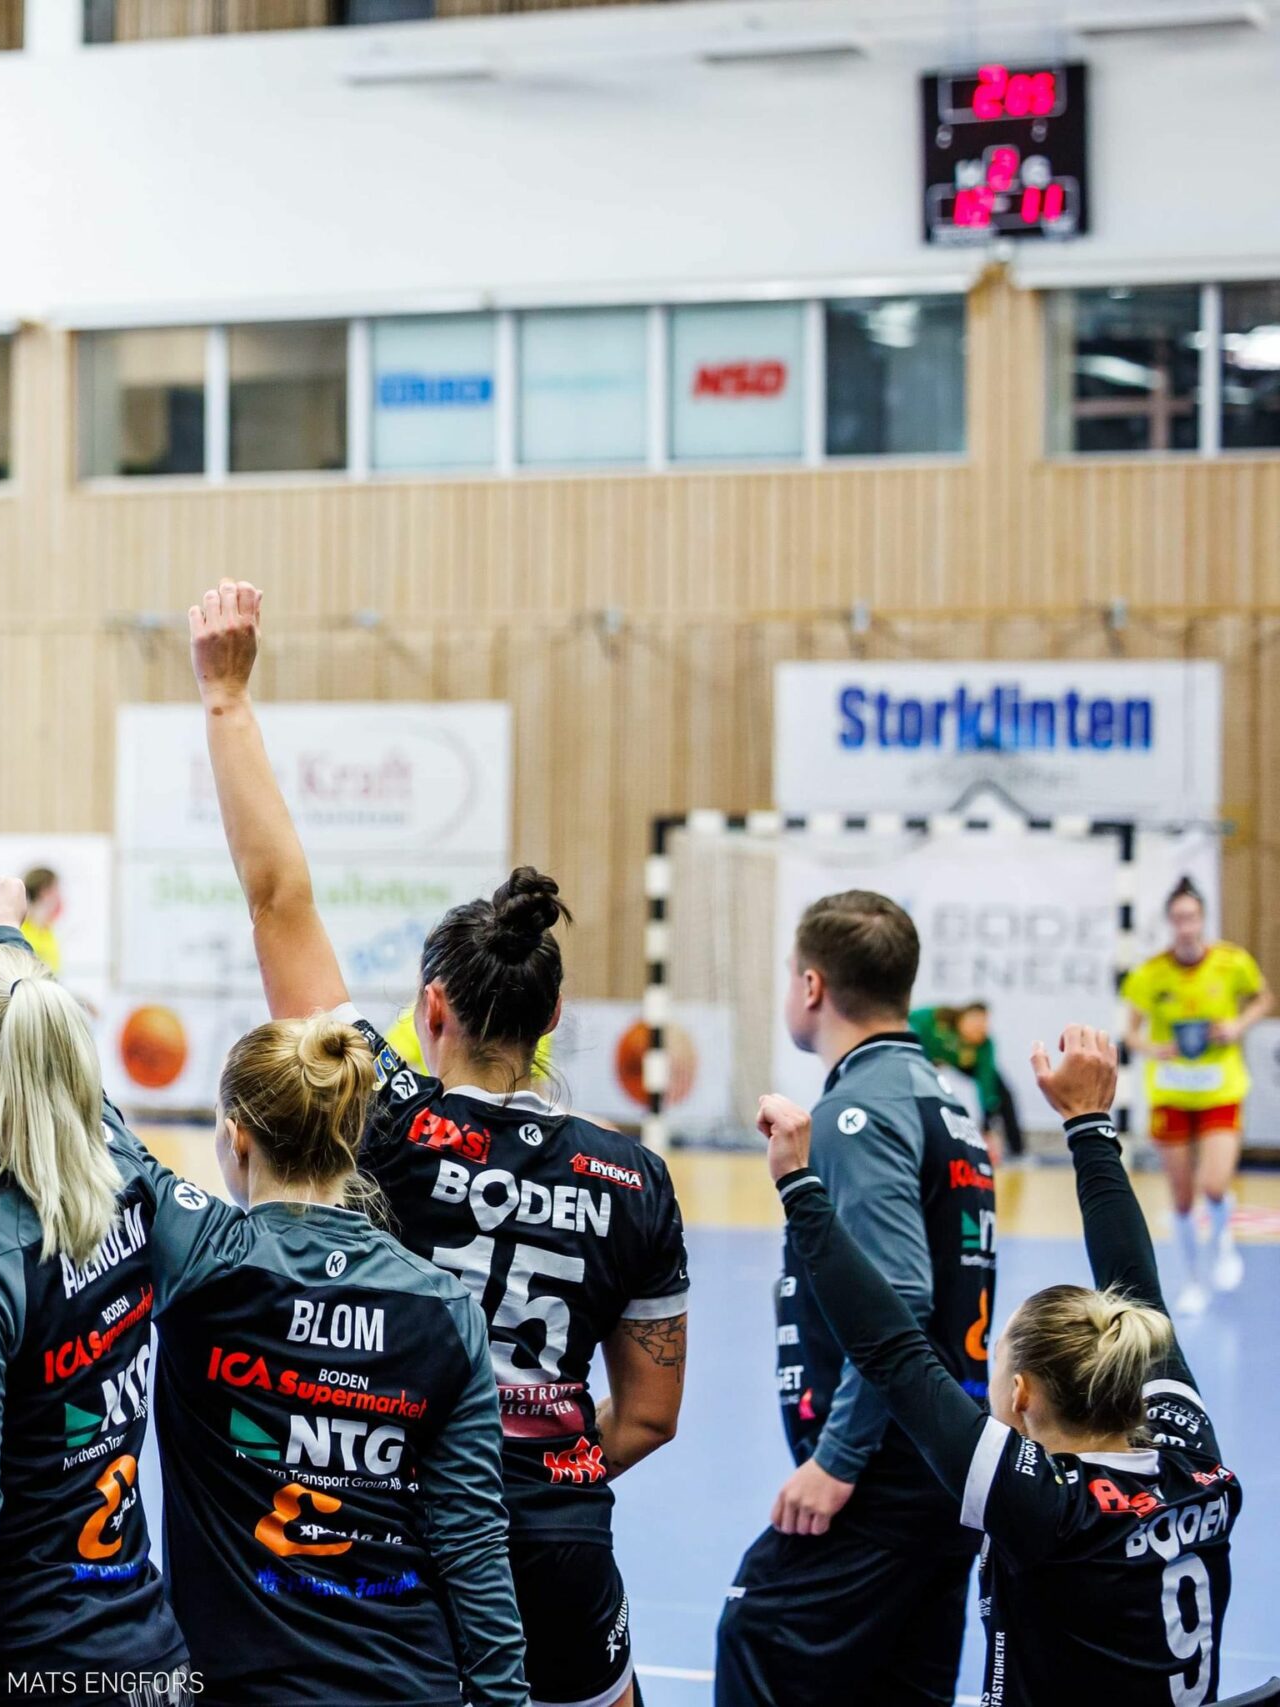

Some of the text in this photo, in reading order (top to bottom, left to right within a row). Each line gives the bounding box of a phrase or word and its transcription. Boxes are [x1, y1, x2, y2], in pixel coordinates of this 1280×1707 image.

[837, 683, 1156, 753] Storklinten
[431, 1159, 611, 1237] BODEN
[589, 1160, 642, 1187] BYGMA
[101, 1295, 131, 1325] BODEN
[286, 1299, 385, 1352] BLOM
[432, 1235, 585, 1385] 15
[44, 1336, 93, 1385] ICA
[207, 1347, 427, 1419] ICA Supermarket
[318, 1368, 369, 1391] BODEN
[285, 1414, 406, 1476] NTG
[289, 1469, 350, 1489] Transport
[1125, 1490, 1229, 1563] BODEN
[1161, 1552, 1214, 1707] 9
